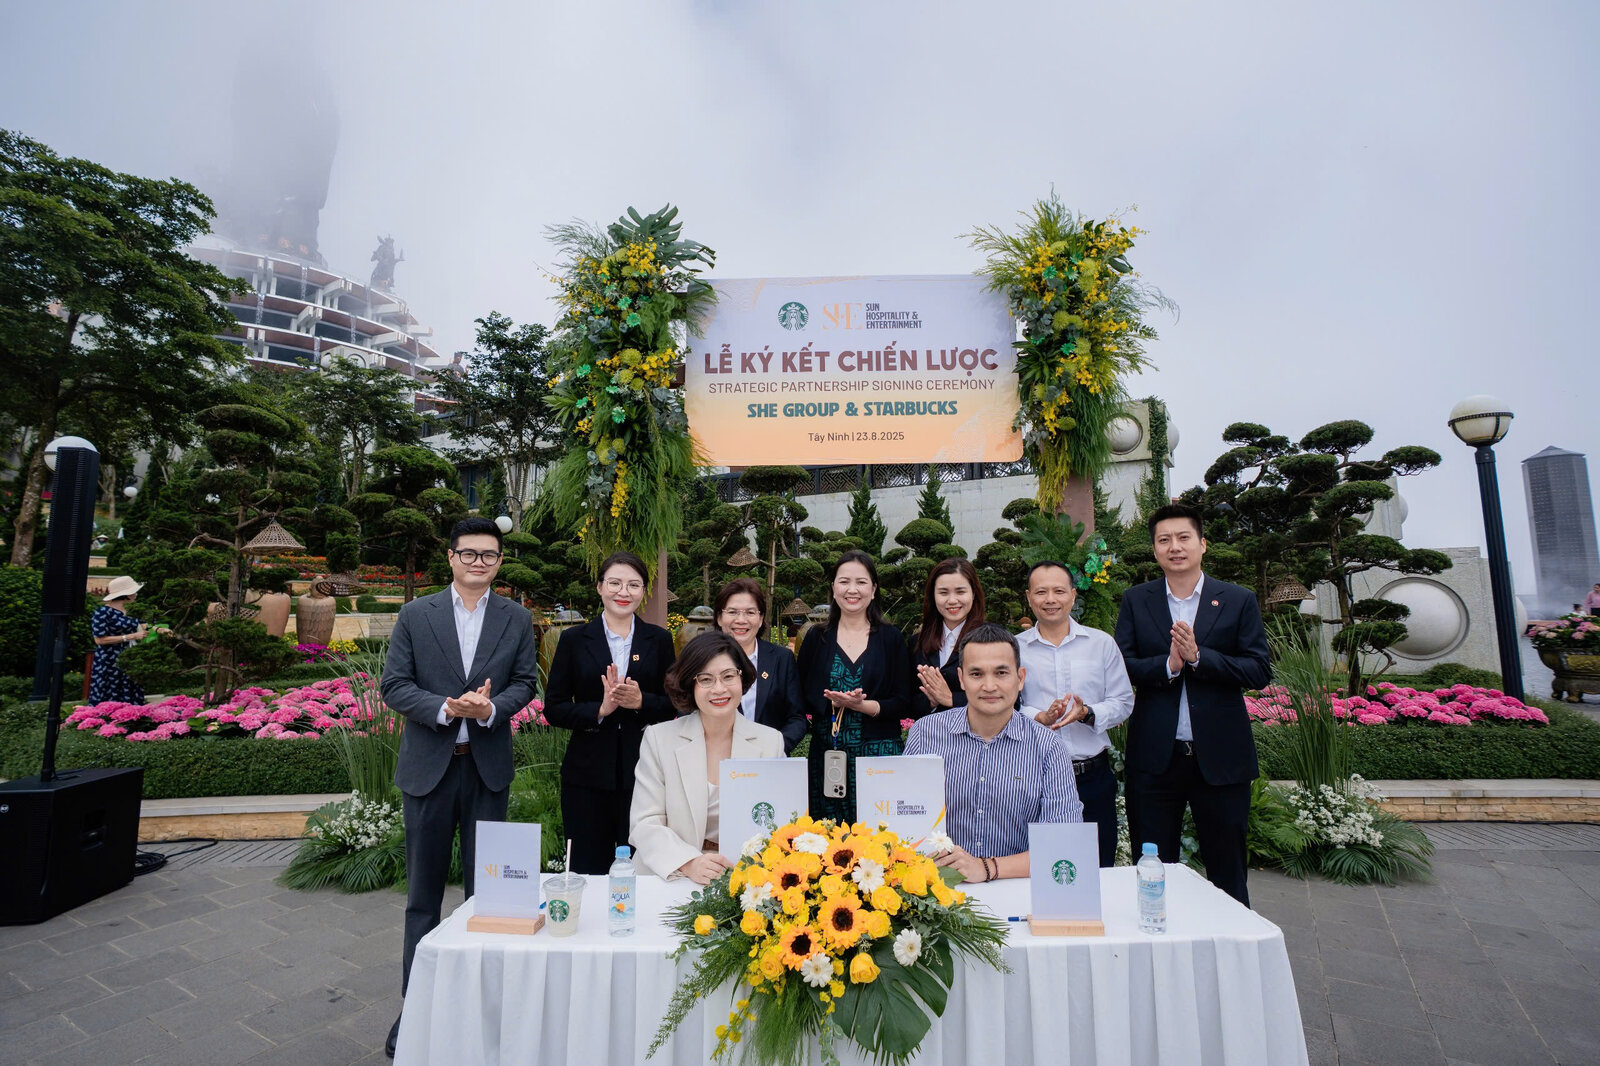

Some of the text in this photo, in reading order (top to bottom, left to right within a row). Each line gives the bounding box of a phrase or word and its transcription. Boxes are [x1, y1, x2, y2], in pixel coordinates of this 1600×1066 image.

[865, 303, 880, 312] SUN
[865, 311, 919, 321] HOSPITALITY &
[866, 320, 922, 330] ENTERTAINMENT
[704, 340, 999, 377] LỄ KÝ KẾT CHIẾN LƯỢC
[708, 379, 995, 394] STRATEGIC PARTNERSHIP SIGNING CEREMONY
[747, 400, 958, 418] SHE GROUP & STARBUCKS
[807, 432, 825, 443] Tây
[827, 432, 850, 441] Ninh
[856, 431, 905, 441] 23.8.2025
